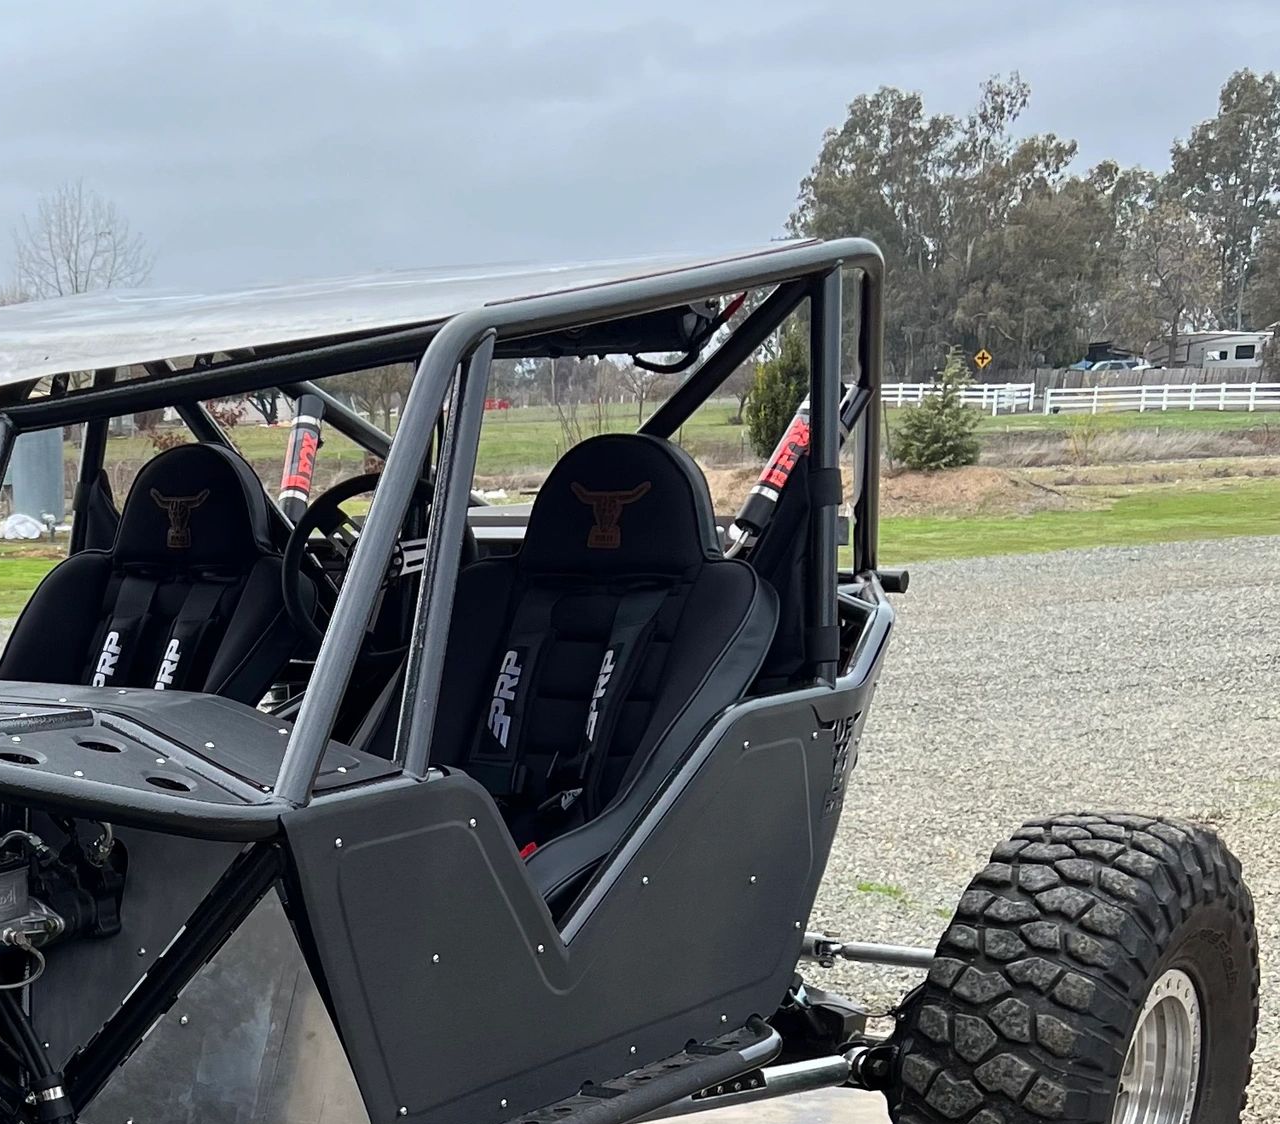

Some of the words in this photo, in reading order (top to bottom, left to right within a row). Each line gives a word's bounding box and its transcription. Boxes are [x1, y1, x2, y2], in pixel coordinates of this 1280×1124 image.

[154, 638, 181, 691] RP
[487, 650, 522, 749] PRP
[586, 650, 616, 742] PRP
